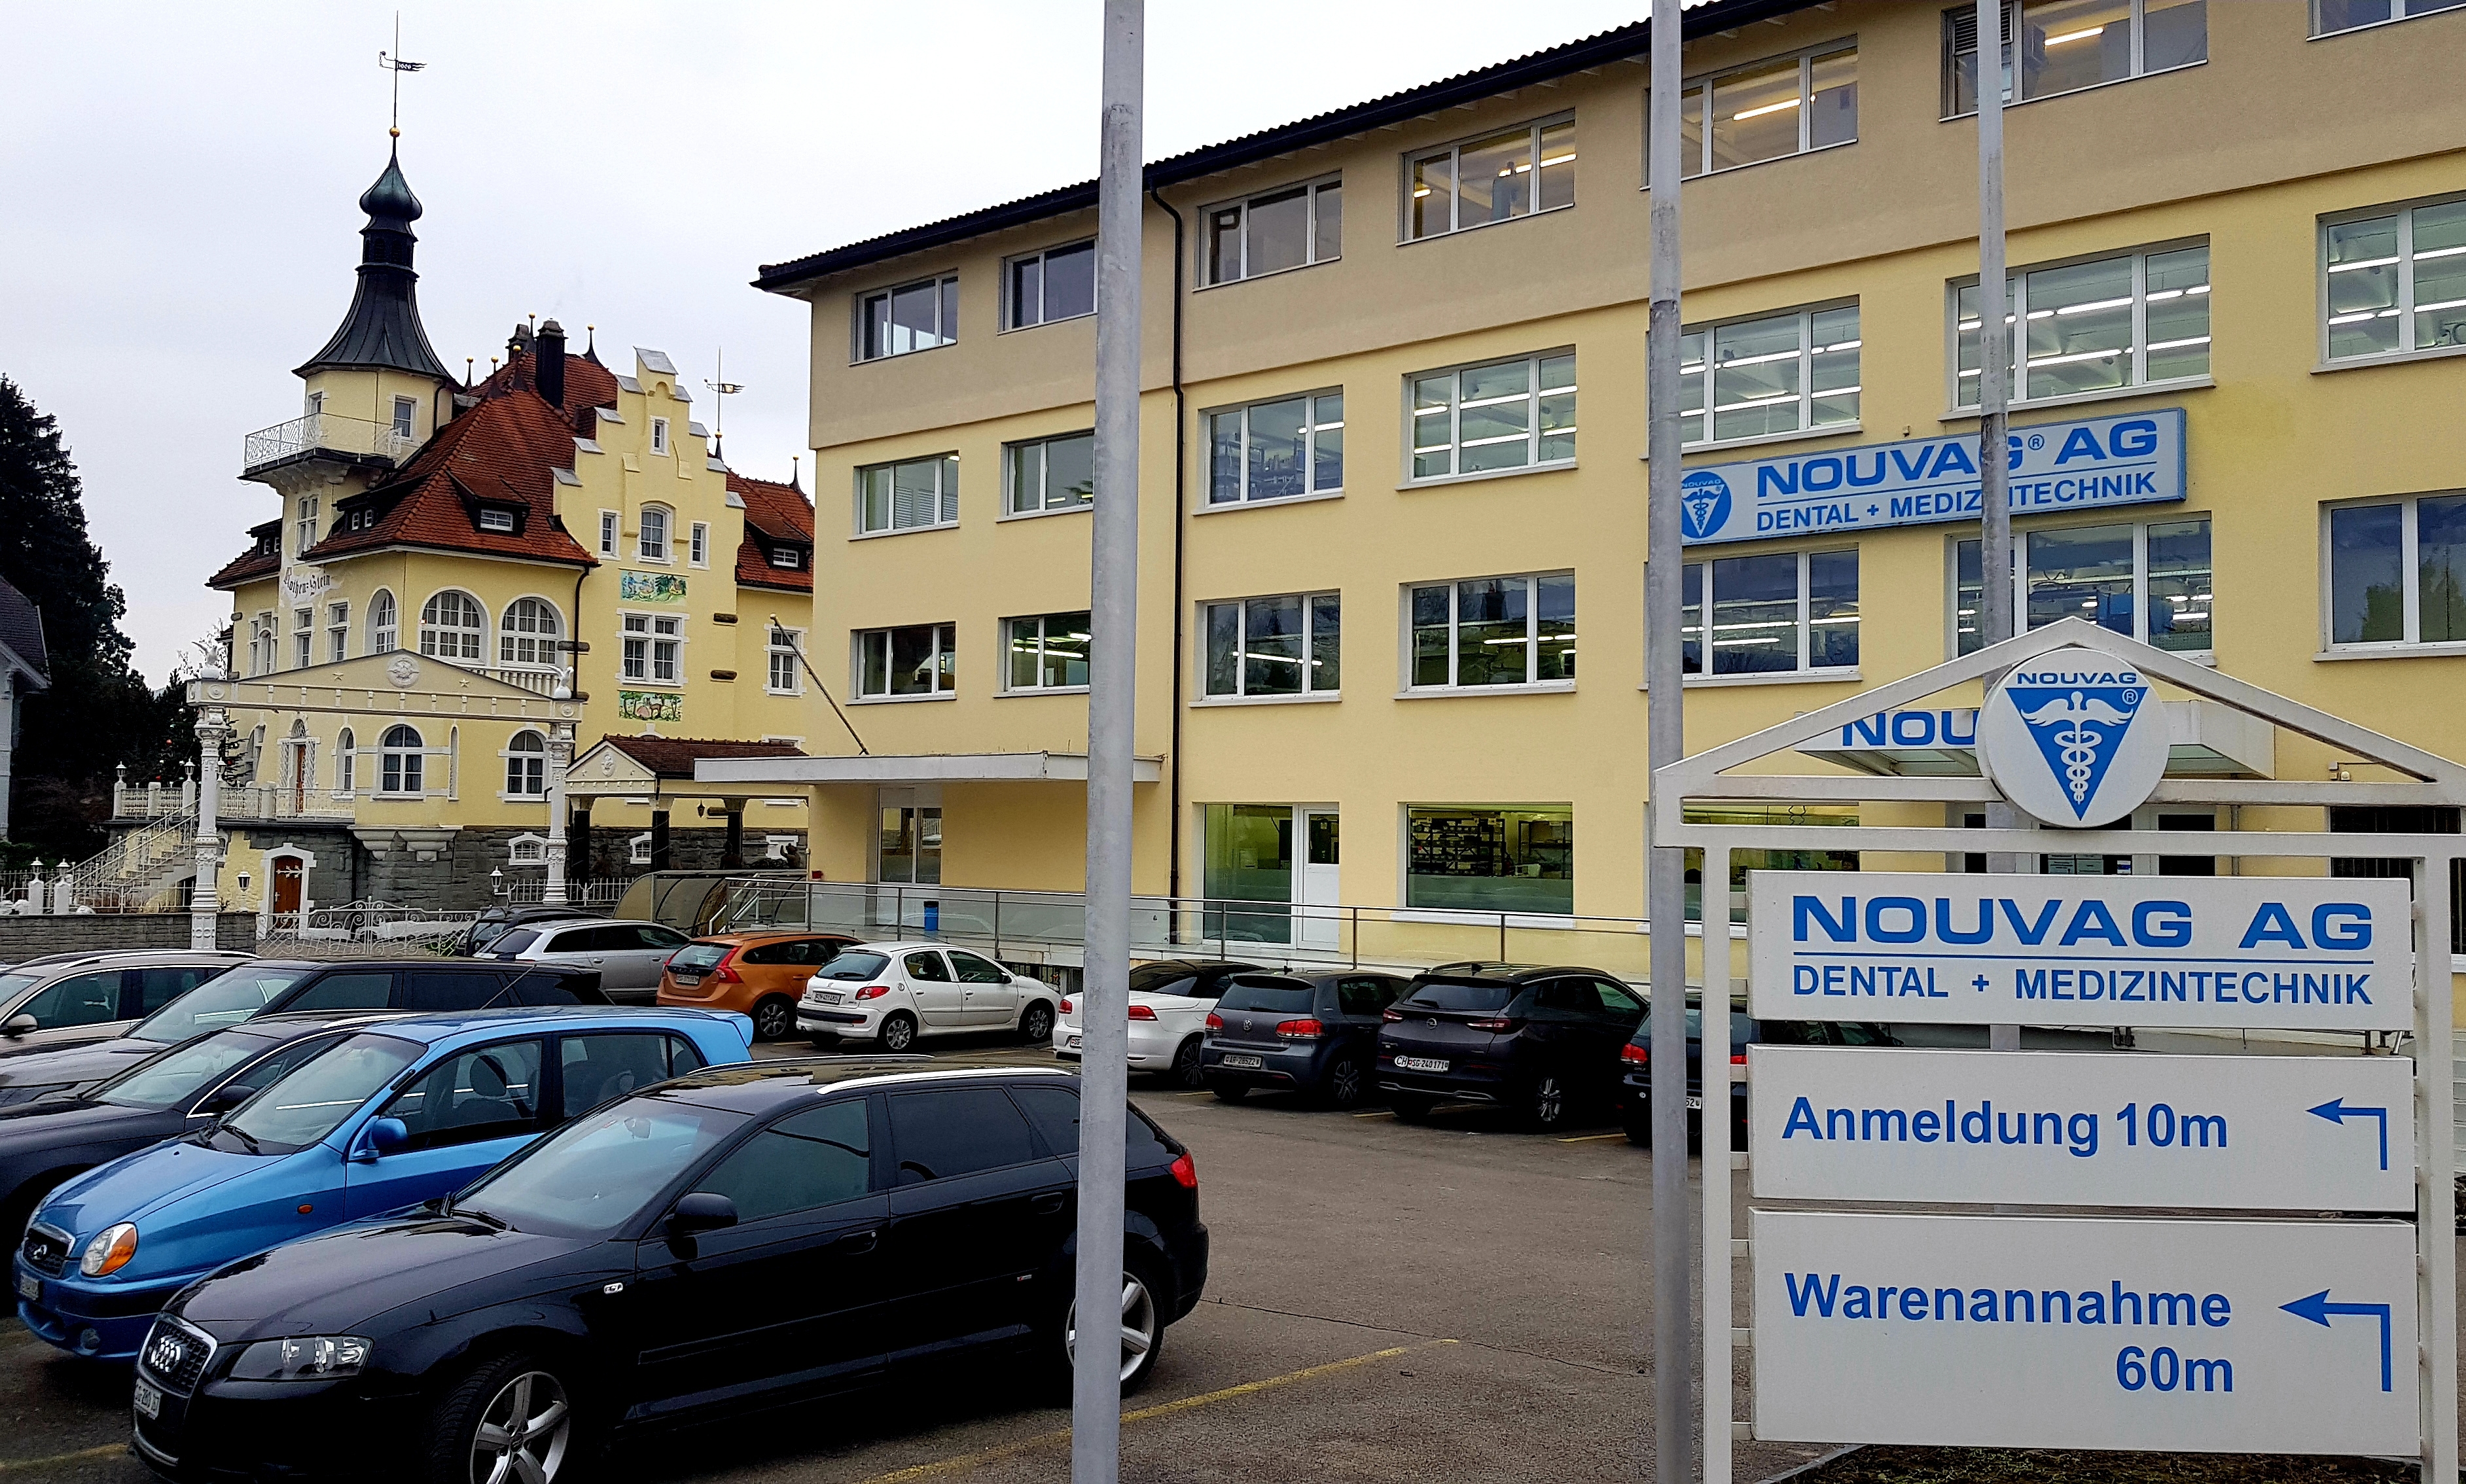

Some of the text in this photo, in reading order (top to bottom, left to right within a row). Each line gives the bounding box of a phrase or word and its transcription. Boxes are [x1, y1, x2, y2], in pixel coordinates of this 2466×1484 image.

[2054, 419, 2158, 465] AG
[1757, 471, 2157, 531] DENTAL + MEDIZTECHNIK
[2017, 672, 2137, 684] NOUVAG
[1793, 896, 2372, 951] NOUVAG AG
[1793, 966, 2372, 1005] DENTAL + MEDIZINTECHNIK
[1396, 1056, 1408, 1066] CH
[1782, 1097, 2228, 1157] Anmeldung 10m
[1785, 1273, 2231, 1328] Warenannahme
[2117, 1346, 2233, 1393] 60m
